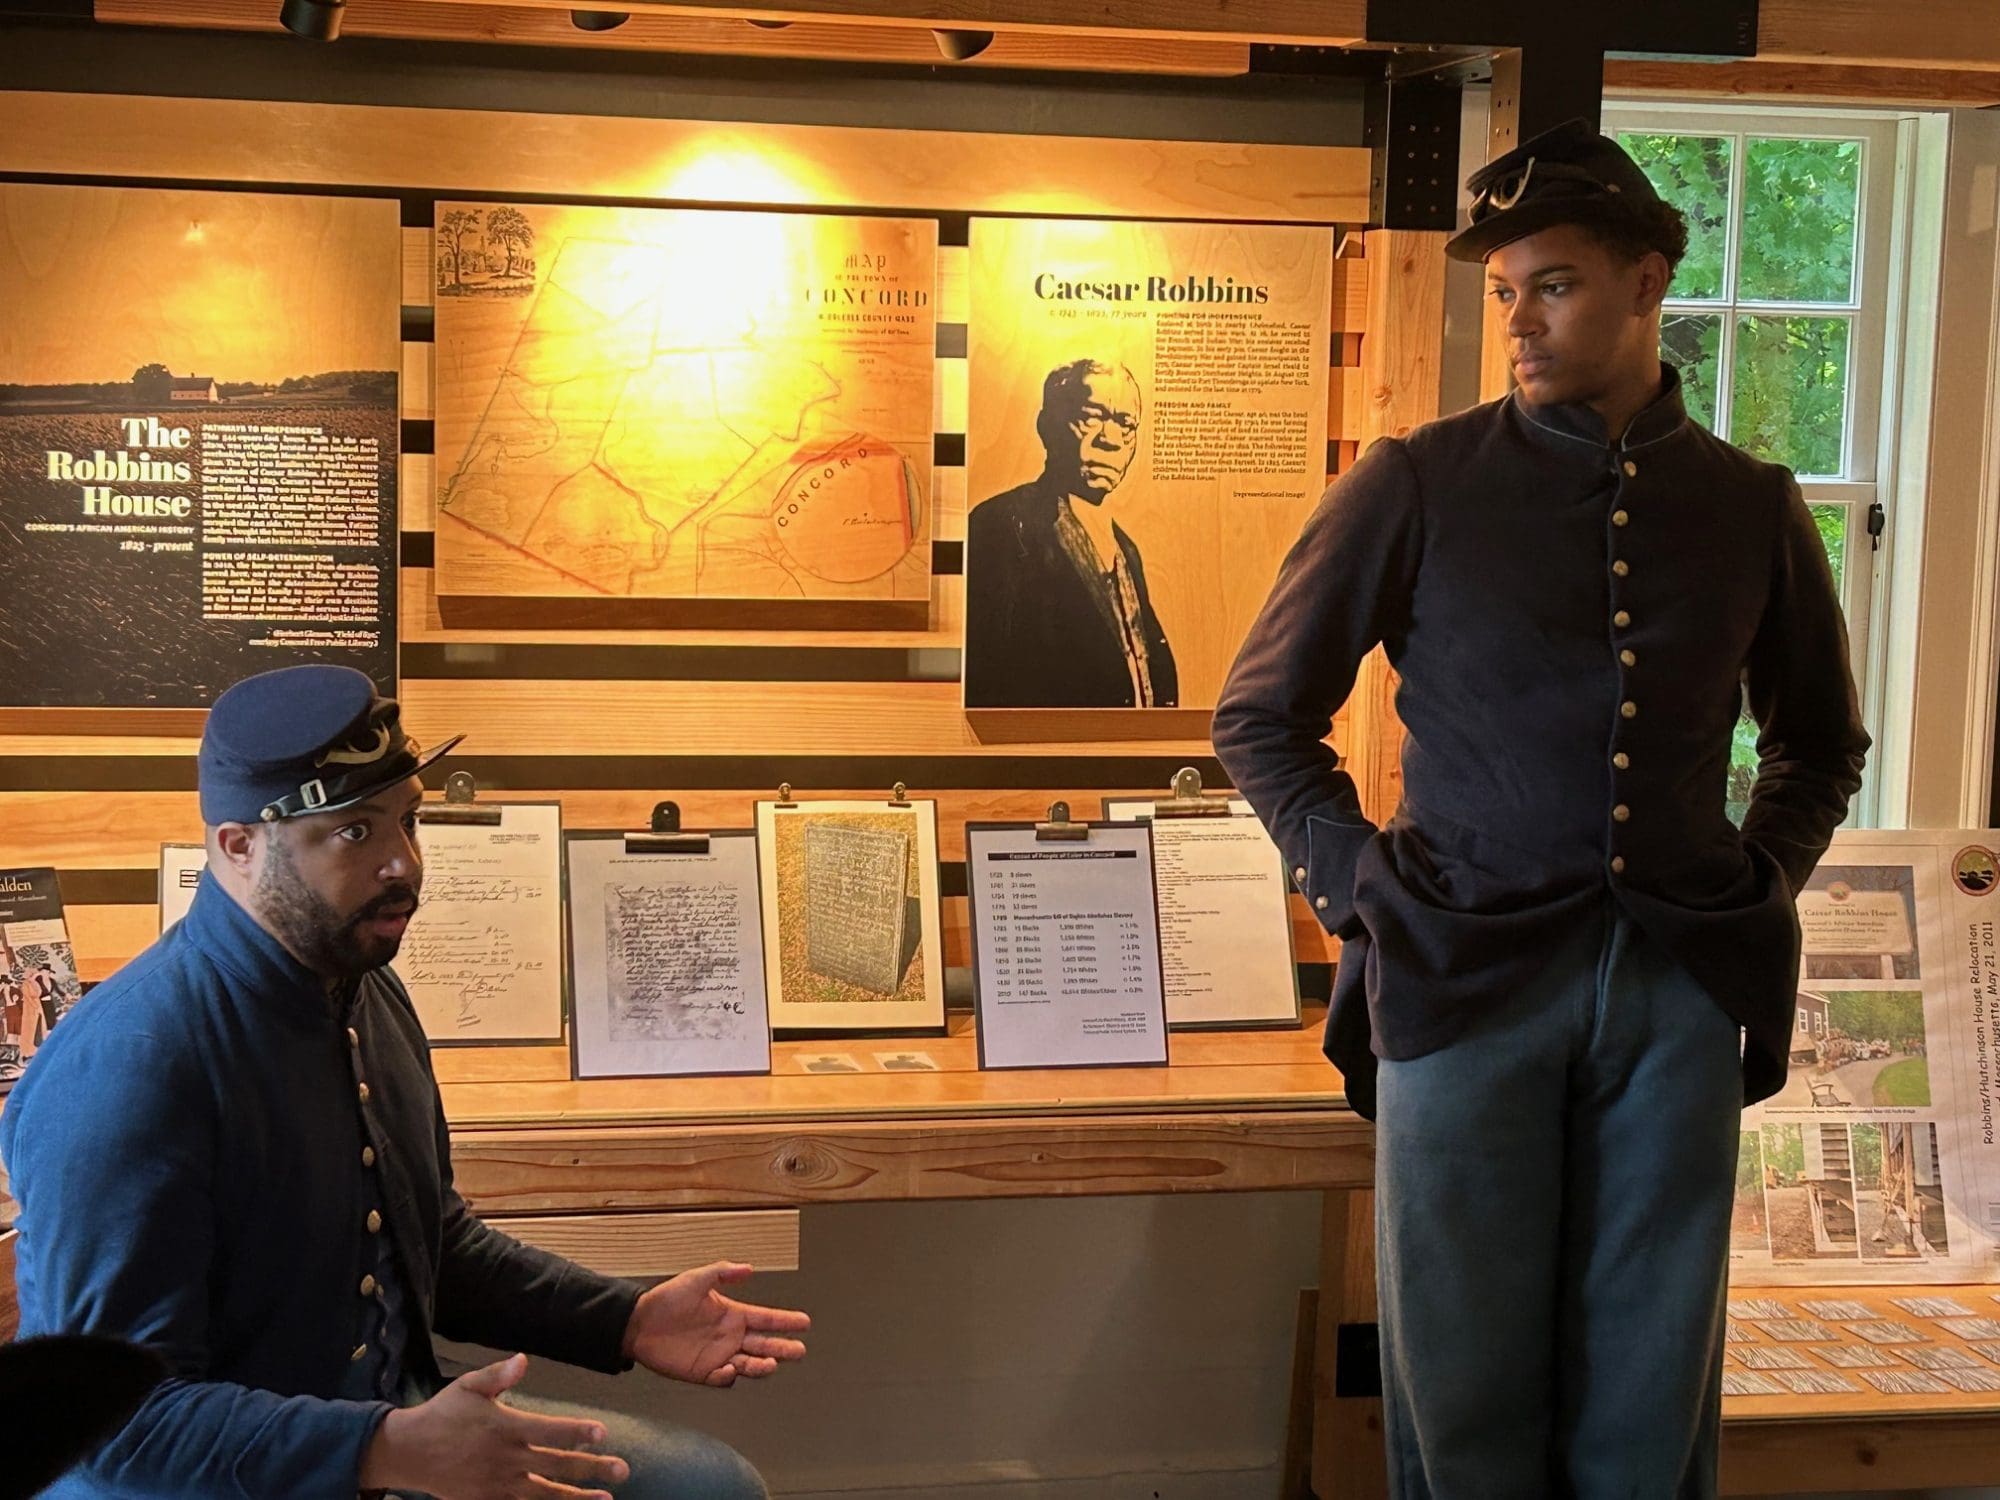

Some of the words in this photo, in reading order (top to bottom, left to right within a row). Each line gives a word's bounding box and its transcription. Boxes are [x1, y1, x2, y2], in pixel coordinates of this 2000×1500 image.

[805, 287, 928, 307] CONCORD
[1034, 273, 1141, 301] Caesar
[1147, 275, 1269, 305] Robbins
[1121, 311, 1147, 320] years
[1208, 313, 1262, 321] INDEPENDENCE
[121, 416, 191, 449] The
[46, 450, 192, 483] Robbins
[777, 448, 867, 527] CONCORD
[82, 486, 192, 518] House
[24, 523, 74, 532] CONCORD'S
[75, 524, 113, 533] AFRICAN
[113, 525, 157, 534] AMERICAN
[158, 526, 195, 535] HISTORY
[153, 541, 194, 553] present
[202, 552, 233, 561] POWER
[0, 876, 33, 893] alden
[1982, 920, 1994, 947] 2011
[1967, 923, 1982, 984] Relocation
[1986, 971, 1999, 995] May
[1972, 987, 1985, 1024] House
[1975, 1026, 1995, 1145] Robbins/Hutchinson
